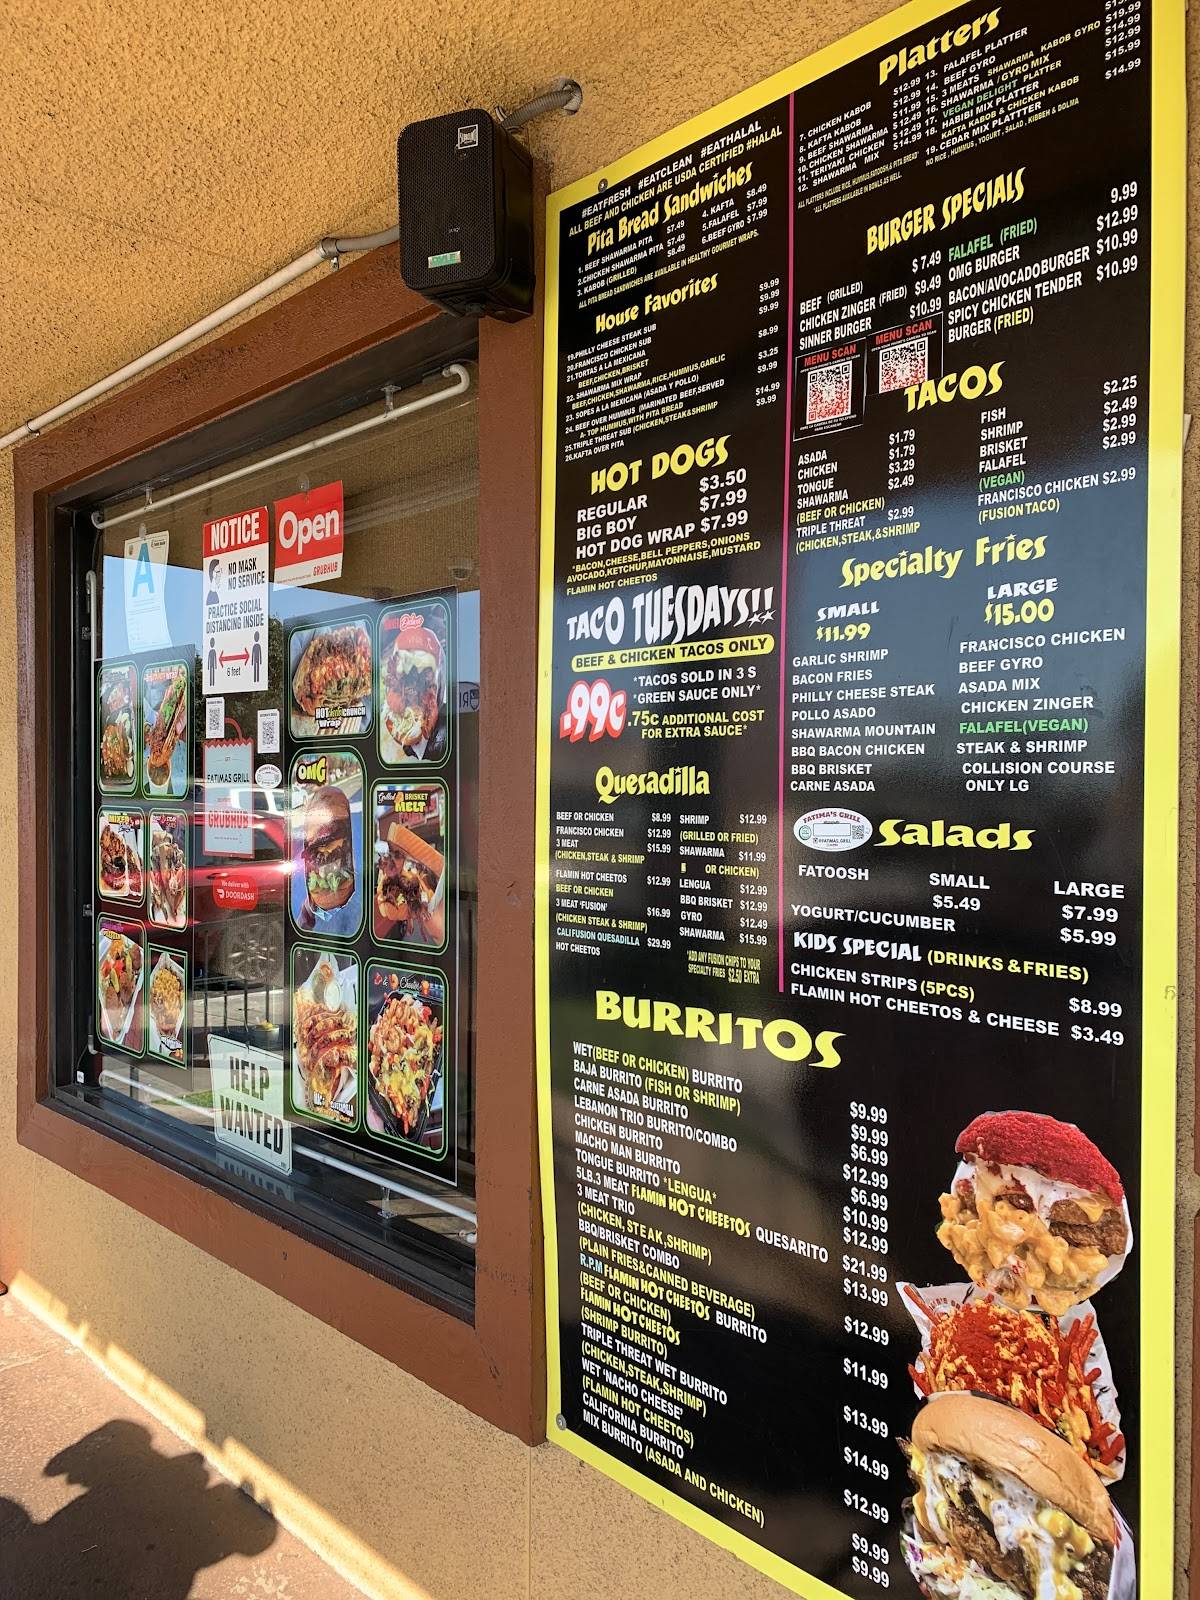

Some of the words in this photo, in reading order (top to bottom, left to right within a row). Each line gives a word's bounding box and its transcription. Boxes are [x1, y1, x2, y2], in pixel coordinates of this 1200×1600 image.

[878, 6, 1001, 86] Platters
[925, 68, 938, 80] 13.
[943, 46, 982, 73] FALAFEL
[985, 27, 1028, 57] PLATTER
[800, 130, 806, 142] 7.
[808, 112, 842, 137] CHICKEN
[844, 101, 872, 122] KABOB
[893, 77, 921, 97] $12.99
[569, 224, 581, 237] ALL
[584, 216, 602, 231] BEEF
[604, 208, 619, 222] AND
[621, 193, 655, 215] CHICKEN
[657, 181, 672, 196] ARE
[675, 170, 697, 186] USDA
[699, 144, 744, 174] CERTIFIED
[746, 125, 782, 151] #HALAL
[582, 185, 631, 218] #EATFRESH
[638, 154, 693, 190] #EATCLEAN
[700, 121, 762, 158] #EATHALAL
[587, 224, 614, 256] Pita
[619, 203, 659, 242] Bread
[663, 162, 753, 224] Sandwiches
[866, 207, 936, 256] BURGER
[941, 166, 1026, 231] SPECIALS
[948, 234, 994, 263] FALAFEL
[1000, 218, 1038, 247] (FRIED)
[1110, 181, 1138, 204] 9.99
[585, 259, 600, 272] BEEF
[601, 244, 637, 265] SHAWARMA
[638, 235, 653, 249] PITA
[667, 220, 685, 233] $7.49
[949, 260, 973, 282] OMG
[975, 245, 1020, 273] BURGER
[1096, 204, 1138, 232] $12.99
[596, 307, 639, 334] House
[644, 272, 718, 316] Favorites
[875, 329, 903, 345] MENU
[906, 319, 932, 336] SCAN
[567, 352, 608, 372] 20.FRANCISCO
[610, 342, 638, 359] CHICKEN
[639, 337, 652, 349] SUB
[804, 351, 829, 366] MENU
[832, 344, 857, 359] SCAN
[903, 360, 1006, 413] TACOS
[981, 407, 1007, 424] FISH
[1103, 375, 1137, 395] $2.25
[798, 450, 828, 465] ASADA
[889, 429, 915, 445] $1.79
[591, 460, 642, 495] HOT
[652, 435, 732, 480] DOGS
[577, 495, 648, 523] REGULAR
[699, 468, 746, 493] $3.50
[211, 512, 259, 551] NOTICE
[279, 510, 339, 555] Open
[576, 542, 607, 560] HOT
[610, 534, 643, 553] DOG
[647, 523, 696, 545] WRAP
[700, 509, 748, 534] $7.99
[132, 543, 154, 597] A
[228, 561, 237, 575] NO
[238, 557, 257, 572] MASK
[313, 562, 338, 577] GRUBHUB
[839, 546, 964, 589] Specialty
[975, 533, 1047, 567] Fries
[228, 577, 236, 590] NO
[237, 571, 265, 587] SERVICE
[208, 602, 237, 619] PRACTICE
[239, 598, 262, 615] SOCIAL
[566, 596, 625, 645] TACO
[632, 585, 776, 645] TUESDAYS!!
[816, 601, 880, 621] SMALL
[987, 578, 1058, 600] LARGE
[206, 617, 241, 634] DISTANCING
[243, 613, 264, 627] INSIDE
[816, 623, 871, 642] $11.99
[984, 598, 1055, 626] $15.00
[576, 656, 604, 669] BEEF
[608, 654, 616, 664] &
[620, 647, 675, 664] CHICKEN
[680, 641, 724, 658] TACOS
[729, 637, 768, 652] ONLY
[792, 652, 836, 667] GARLIC
[840, 649, 889, 664] SHRIMP
[960, 635, 1046, 654] FRANCISCO
[1051, 628, 1126, 645] CHICKEN
[227, 668, 230, 676] 6
[232, 666, 240, 676] feet
[681, 670, 715, 684] SOLD
[718, 668, 732, 680] IN
[736, 667, 745, 679] 3
[748, 666, 757, 678] S
[792, 672, 833, 685] BACON
[836, 669, 873, 682] FRIES
[315, 707, 328, 719] HOT
[342, 706, 366, 717] CRUNCH
[678, 689, 718, 701] SAUCE
[318, 719, 342, 729] Wrap
[642, 728, 663, 739] FOR
[665, 727, 701, 738] EXTRA
[662, 712, 729, 725] ADDITIONAL
[732, 710, 765, 722] COST
[959, 718, 1088, 735] FALAFEL(VEGAN)
[207, 773, 232, 783] FATIMAS
[233, 773, 249, 783] GRILL
[297, 758, 326, 783] OMG
[596, 766, 710, 804] Quesadilla
[962, 761, 1043, 775] COLLISION
[1047, 761, 1115, 774] COURSE
[208, 810, 249, 828] GRUBHUB
[395, 801, 426, 812] MELT
[556, 812, 573, 821] BEEF
[574, 813, 583, 821] OR
[584, 812, 614, 822] CHICKEN
[652, 812, 671, 823] $8.99
[680, 815, 709, 825] SHRIMP
[739, 814, 767, 825] $12.99
[803, 811, 837, 823] FATIMA'S
[839, 812, 861, 822] GRILL
[873, 819, 1037, 851] Salads
[226, 891, 254, 900] DOORDASH
[798, 865, 869, 880] FATOOSH
[929, 872, 990, 889] SMALL
[1053, 880, 1125, 899] LARGE
[791, 904, 955, 932] YOGURT/CUCUMBER
[1060, 927, 1117, 946] $5.99
[932, 895, 981, 911] $5.49
[1062, 904, 1119, 923] $7.99
[793, 932, 836, 952] KIDS
[841, 937, 922, 962] SPECIAL
[927, 950, 1003, 972] (DRINKS
[790, 963, 857, 983] CHICKEN
[861, 973, 917, 992] STRIPS
[920, 980, 975, 1002] (5PCS)
[1069, 997, 1123, 1018] $8.99
[596, 990, 847, 1069] BURRITOS
[229, 1055, 269, 1101] HELP
[220, 1094, 284, 1155] WANTED
[849, 1101, 888, 1124] $9.99
[575, 1130, 609, 1152] MACHO
[611, 1142, 632, 1160] MAN
[634, 1149, 681, 1175] BURRITO
[583, 1409, 600, 1431] MIX
[602, 1420, 642, 1454] BURRITO
[645, 1444, 682, 1479] (ASADA
[684, 1467, 707, 1491] AND
[710, 1482, 765, 1528] CHICKEN)
[852, 1556, 890, 1588] $9.99
